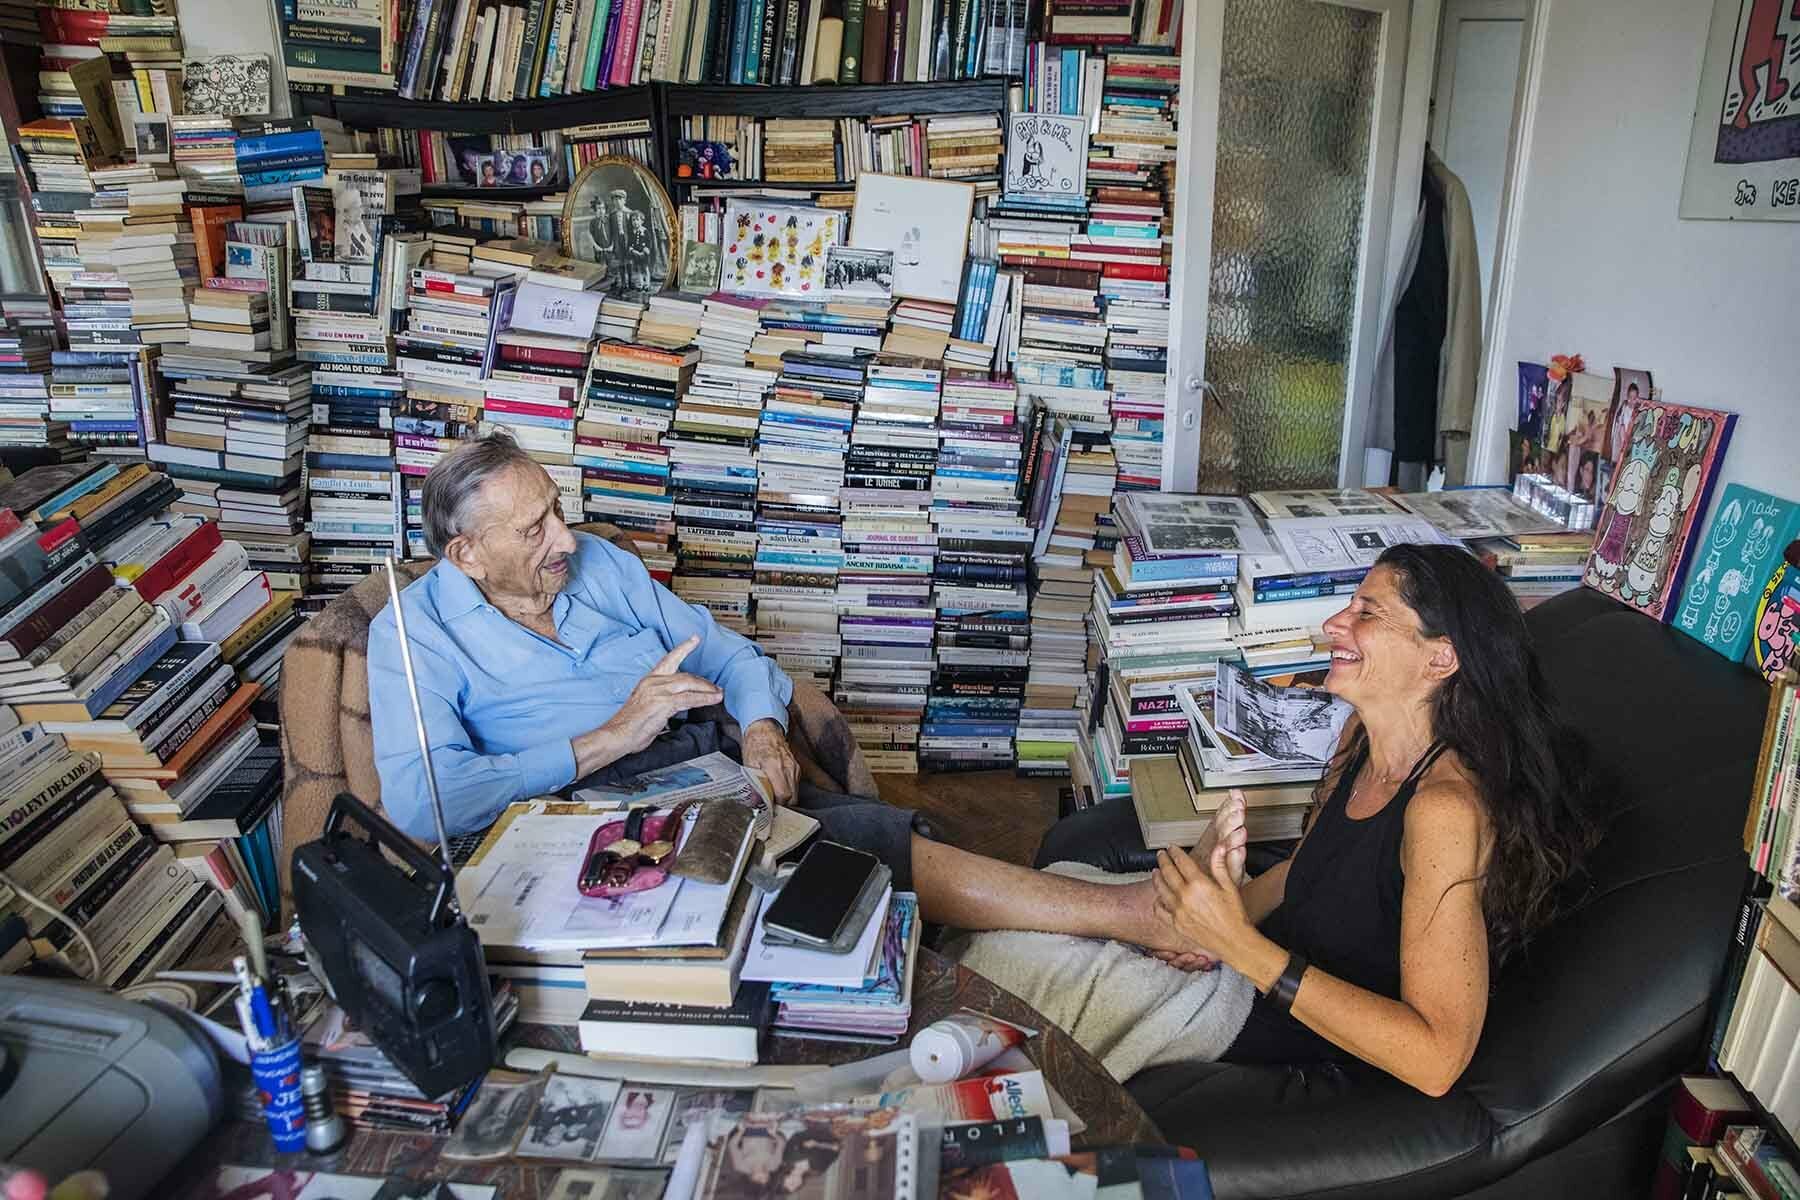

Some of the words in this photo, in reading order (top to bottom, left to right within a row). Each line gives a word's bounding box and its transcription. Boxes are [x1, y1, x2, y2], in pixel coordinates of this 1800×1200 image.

[299, 8, 326, 18] myth
[338, 173, 352, 182] Ben
[353, 174, 384, 184] Gourion
[348, 344, 385, 353] TREPPER
[320, 363, 331, 371] AU
[332, 364, 351, 372] NOM
[363, 366, 382, 374] DIEU
[875, 478, 901, 488] TUNNEL
[845, 560, 874, 568] ANCIENT
[897, 687, 925, 695] ALICIA
[1138, 699, 1169, 711] NAZI
